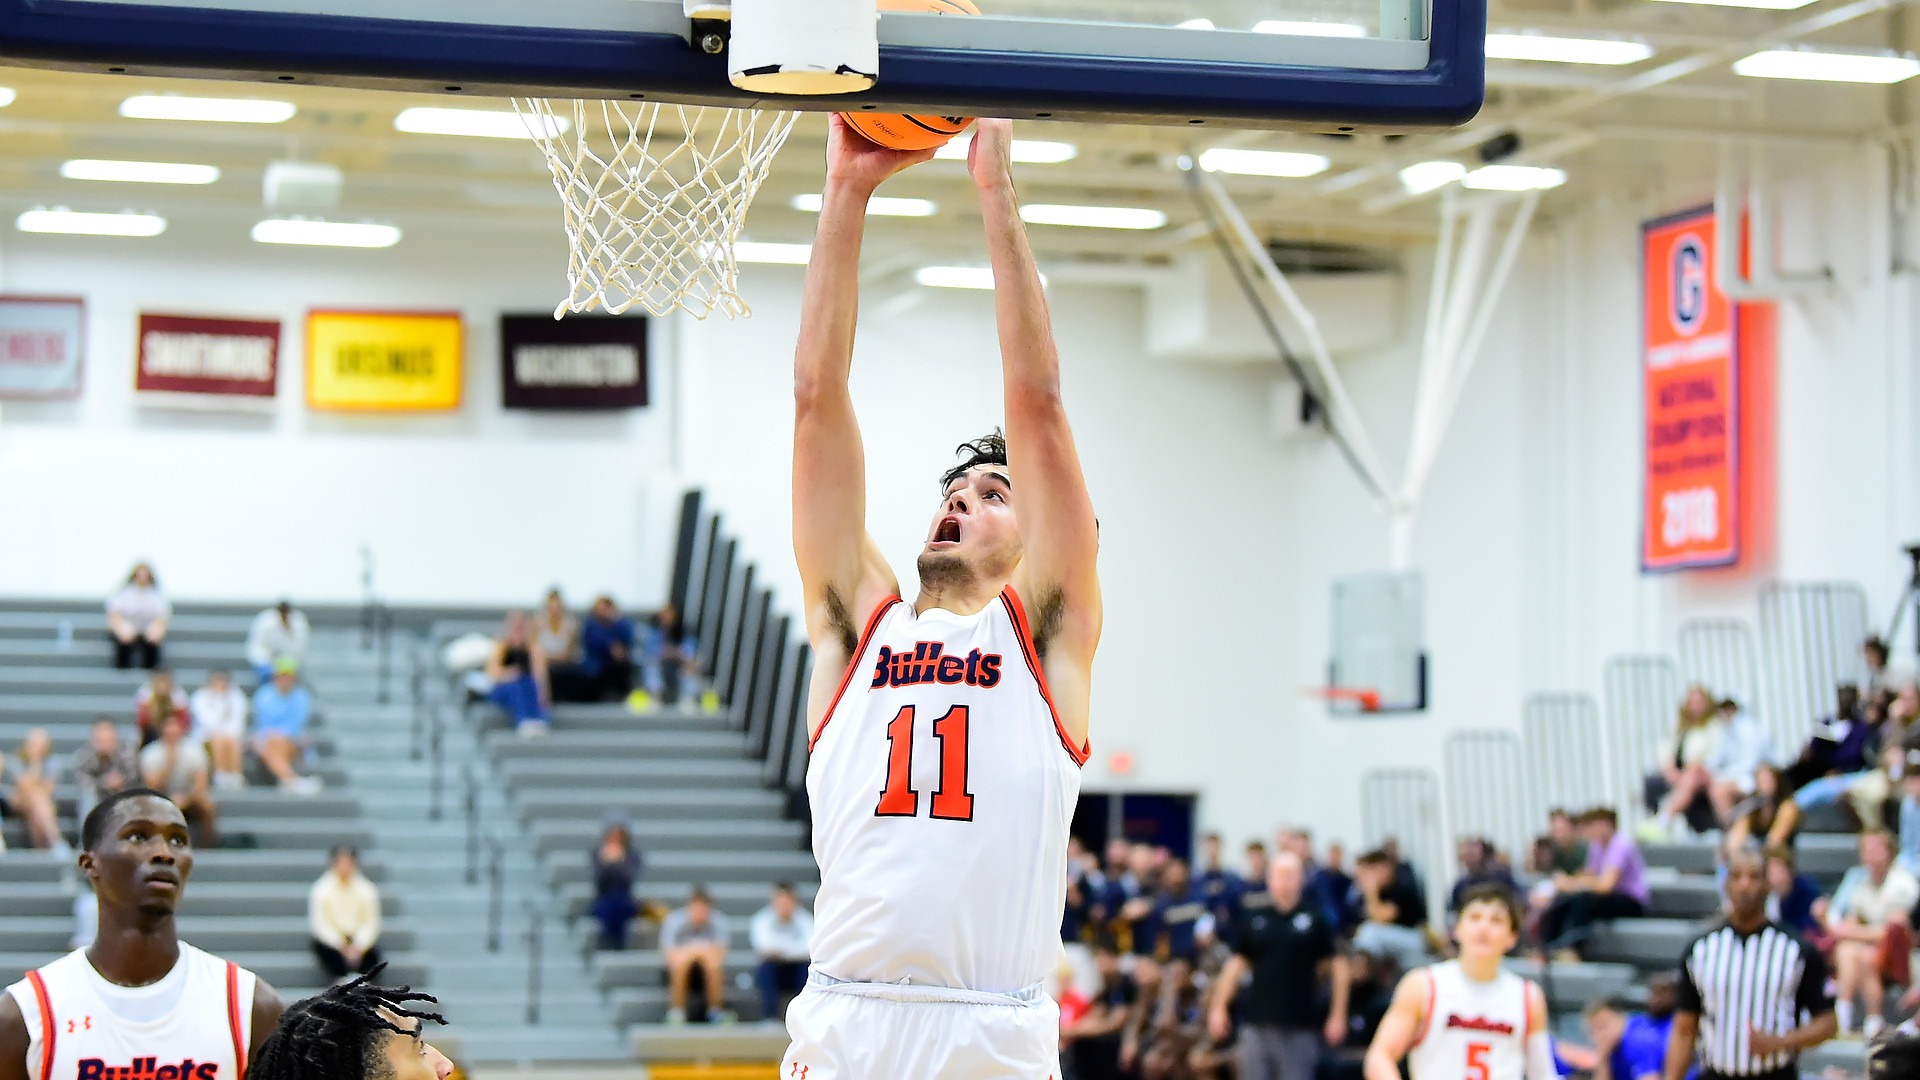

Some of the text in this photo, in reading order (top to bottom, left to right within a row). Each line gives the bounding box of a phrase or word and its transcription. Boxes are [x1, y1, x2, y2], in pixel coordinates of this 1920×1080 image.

[871, 641, 1002, 690] Bullets
[874, 704, 975, 822] 11
[1466, 1043, 1491, 1080] 5
